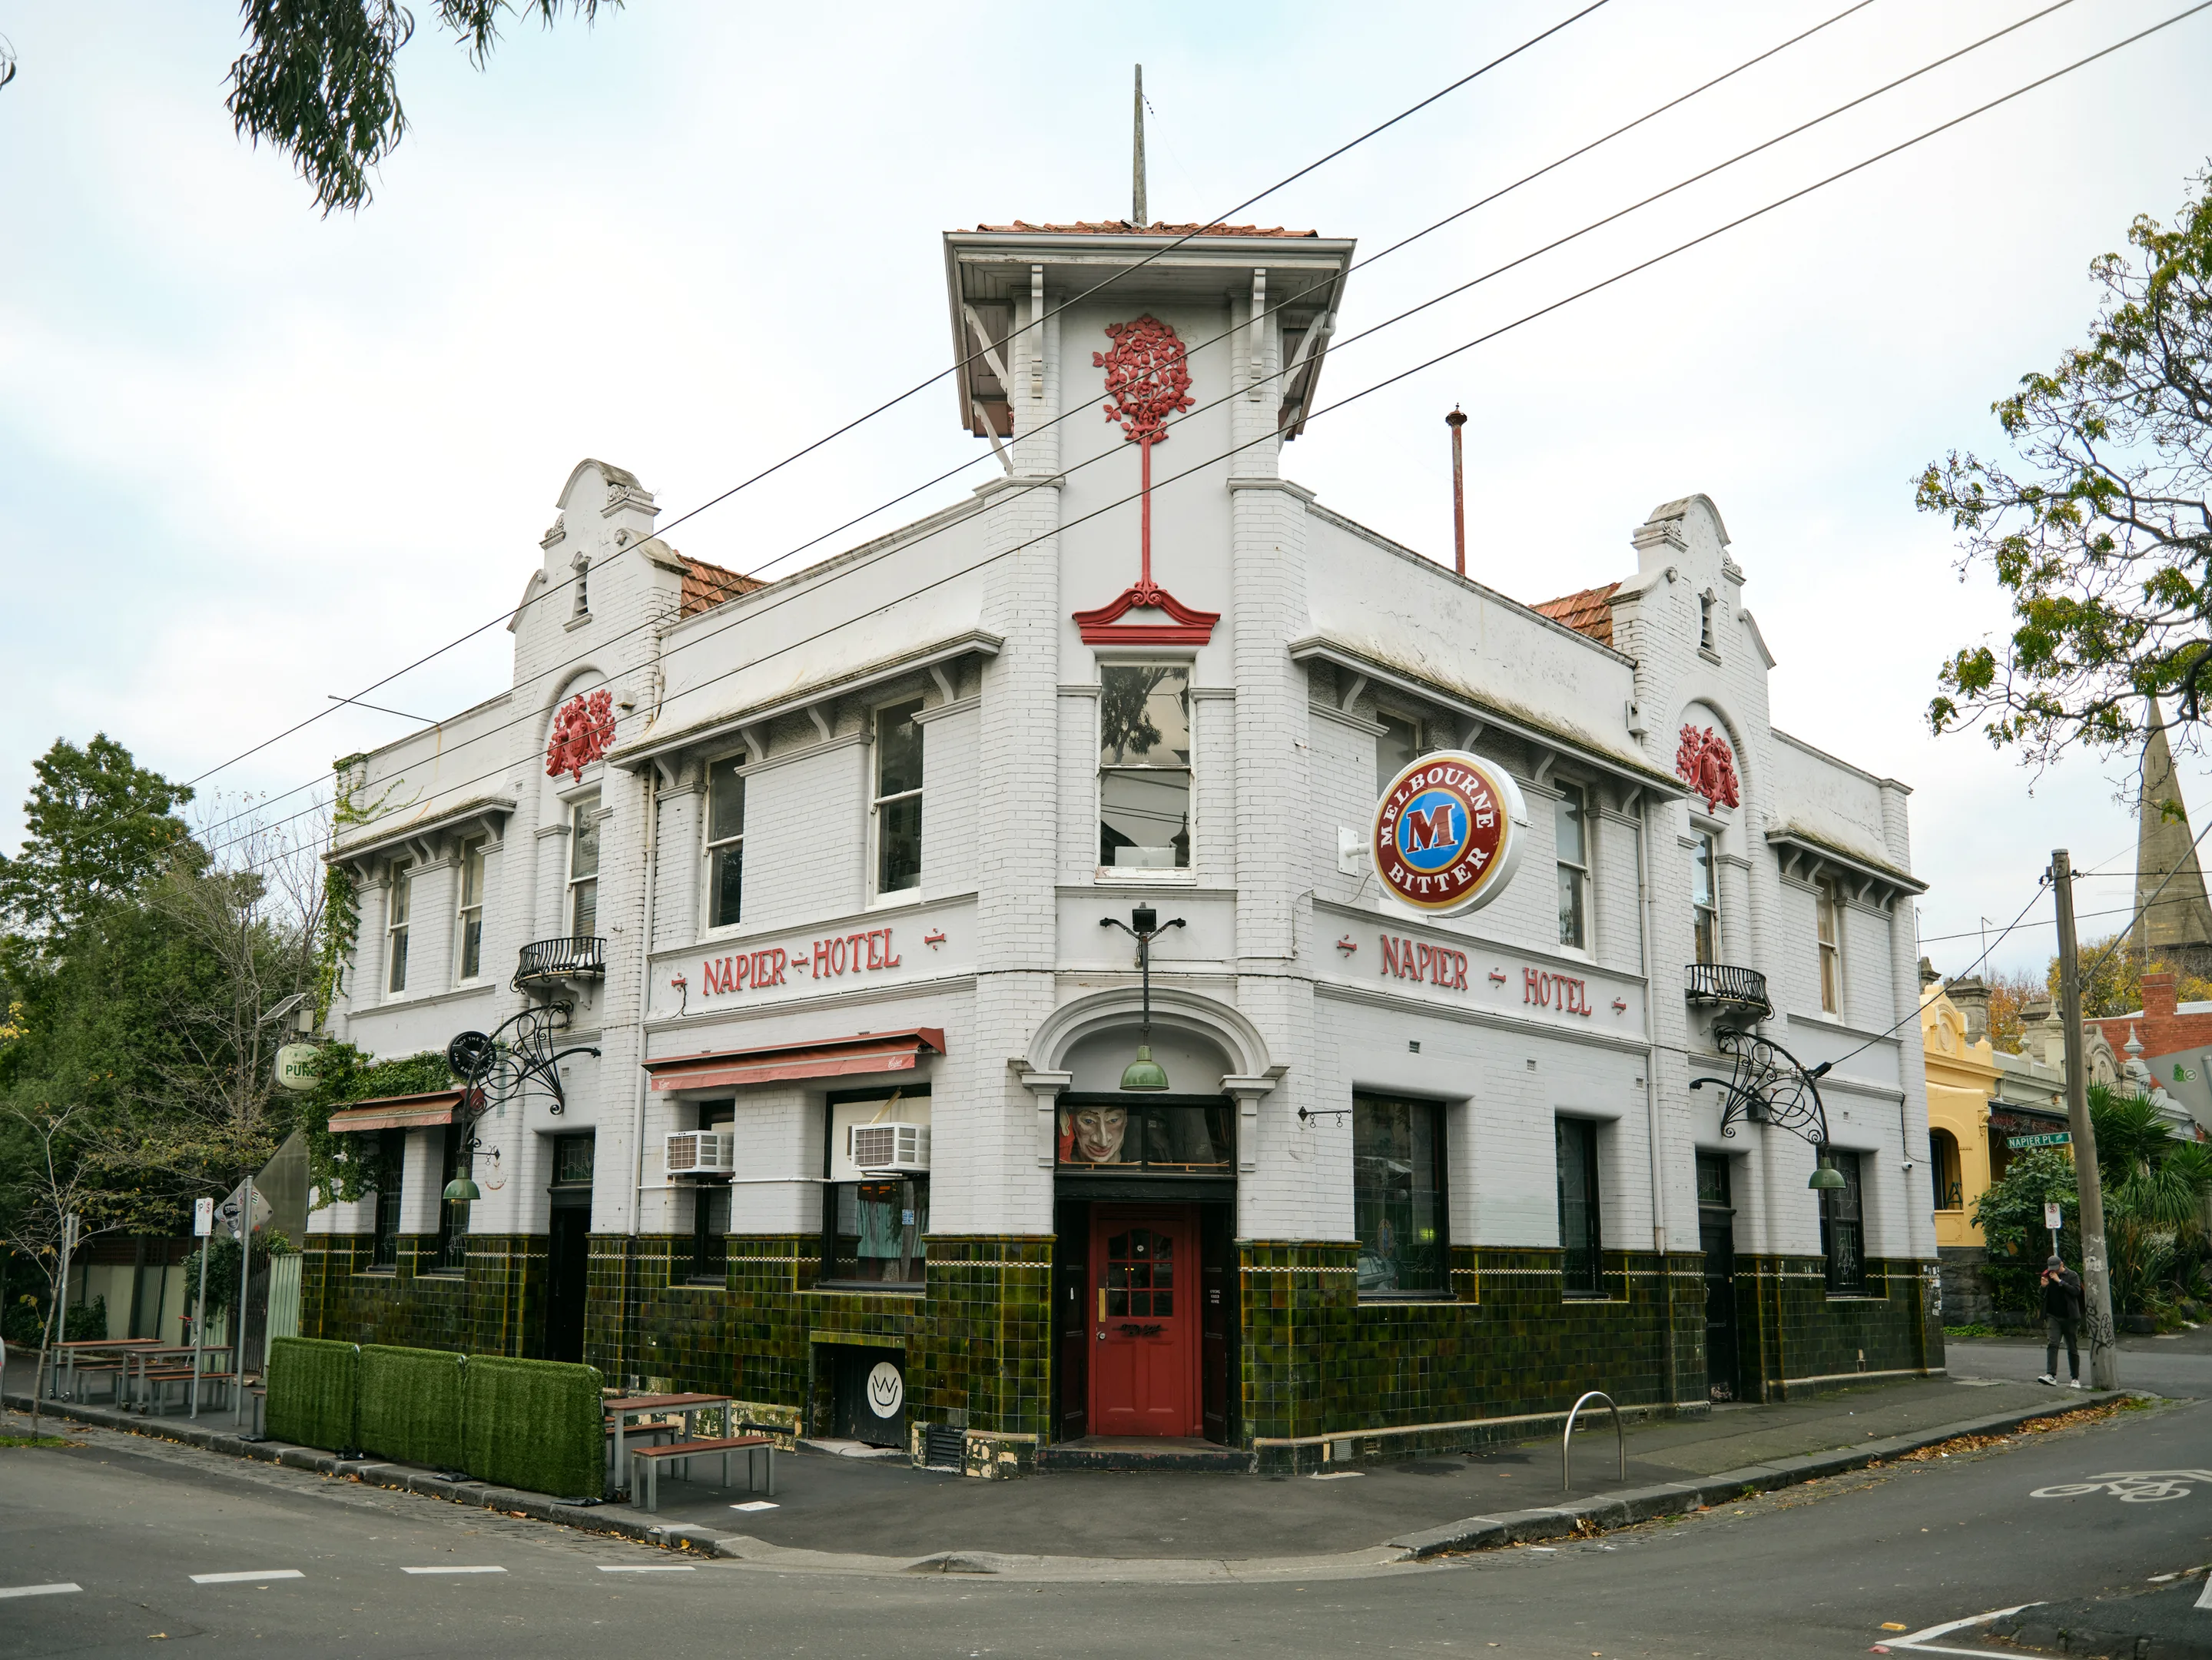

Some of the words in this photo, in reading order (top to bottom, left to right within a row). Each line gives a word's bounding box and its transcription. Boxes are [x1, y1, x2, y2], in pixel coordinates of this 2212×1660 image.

[1381, 767, 1494, 848] MELBOURNE
[1405, 802, 1458, 855] M
[1388, 847, 1489, 894] BITTER
[703, 947, 787, 996] NAPIER
[812, 928, 902, 979] HOTEL
[1381, 934, 1468, 991] NAPIER
[1524, 967, 1592, 1016] HOTEL
[459, 1066, 488, 1075] BREING
[2009, 1136, 2041, 1147] NAPIER
[2042, 1135, 2054, 1144] PL
